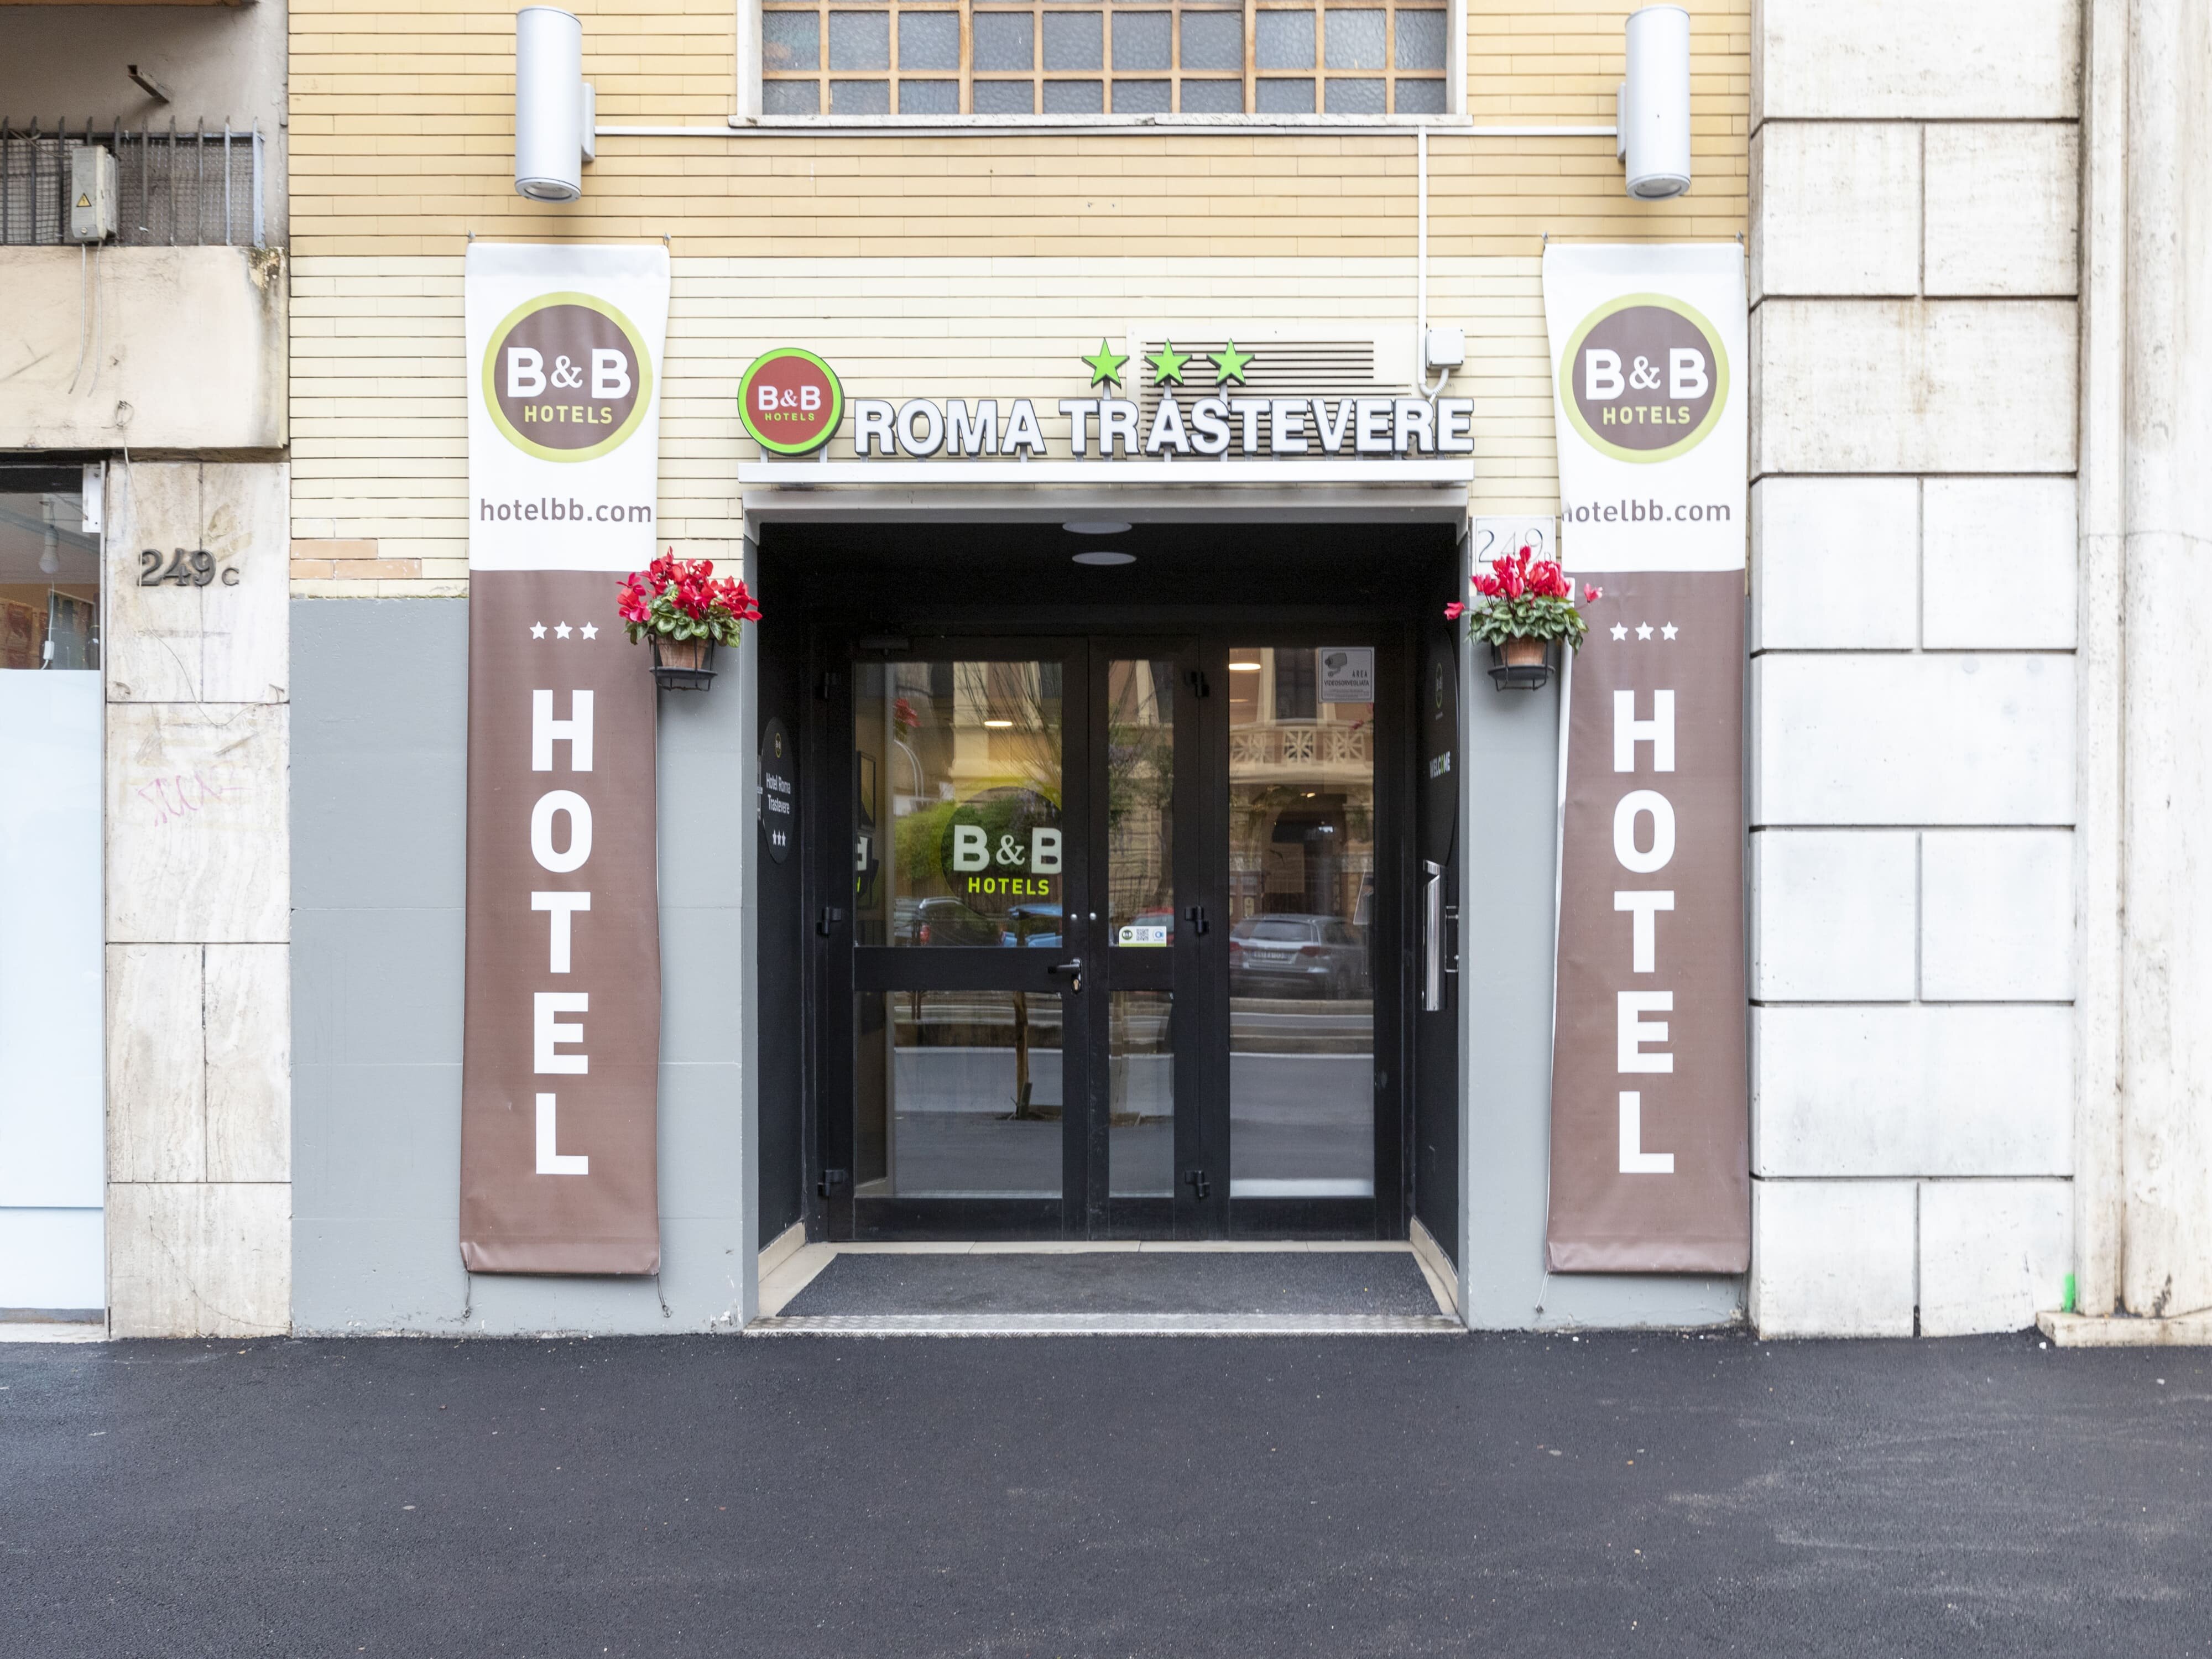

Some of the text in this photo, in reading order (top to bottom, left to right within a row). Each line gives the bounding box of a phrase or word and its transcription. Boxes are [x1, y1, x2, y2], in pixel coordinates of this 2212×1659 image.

[507, 347, 631, 399] B&B
[1585, 347, 1709, 400] B&B
[758, 385, 821, 411] B&B
[524, 405, 613, 425] HOTELS
[764, 412, 815, 422] HOTELS
[854, 398, 1474, 456] ROMA TRASTEVERE
[1603, 406, 1691, 425] HOTELS
[480, 498, 651, 523] hotelbb.com
[137, 548, 216, 587] 249
[1352, 670, 1368, 678] AREA
[1429, 750, 1451, 779] WELCOME
[766, 772, 791, 795] Hotel Roma
[767, 794, 790, 815] Trastevere
[953, 825, 1062, 874] B&B
[968, 877, 1050, 895] HOTELS
[531, 689, 594, 1175] HOTEL
[1613, 689, 1676, 1173] HOTEL
